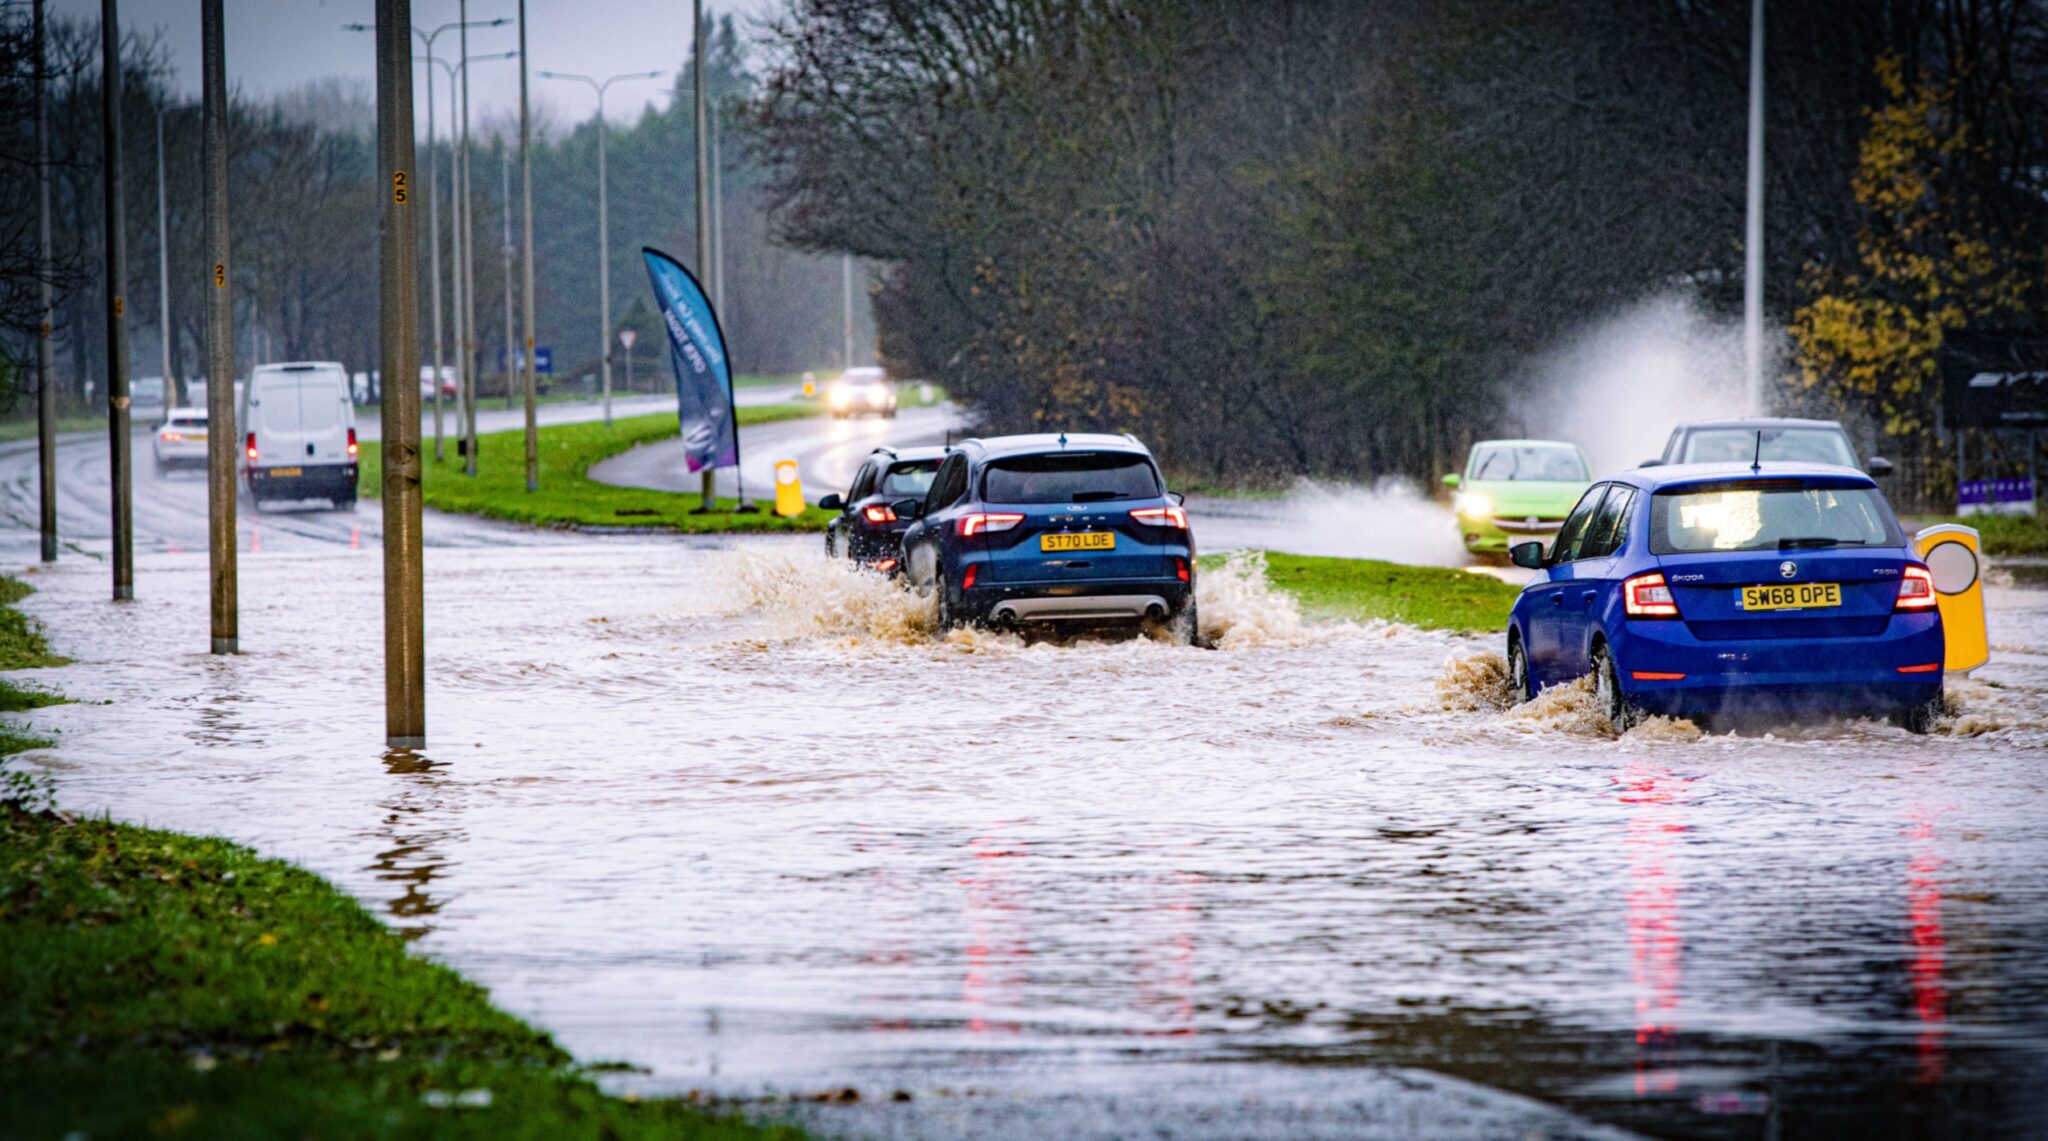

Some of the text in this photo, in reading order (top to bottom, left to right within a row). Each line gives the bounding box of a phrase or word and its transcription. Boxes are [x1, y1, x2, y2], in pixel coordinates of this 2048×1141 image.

[395, 172, 406, 202] 25
[215, 264, 224, 286] 27
[1047, 533, 1109, 548] ST70 LDE
[1746, 585, 1837, 606] SW68 OPE
